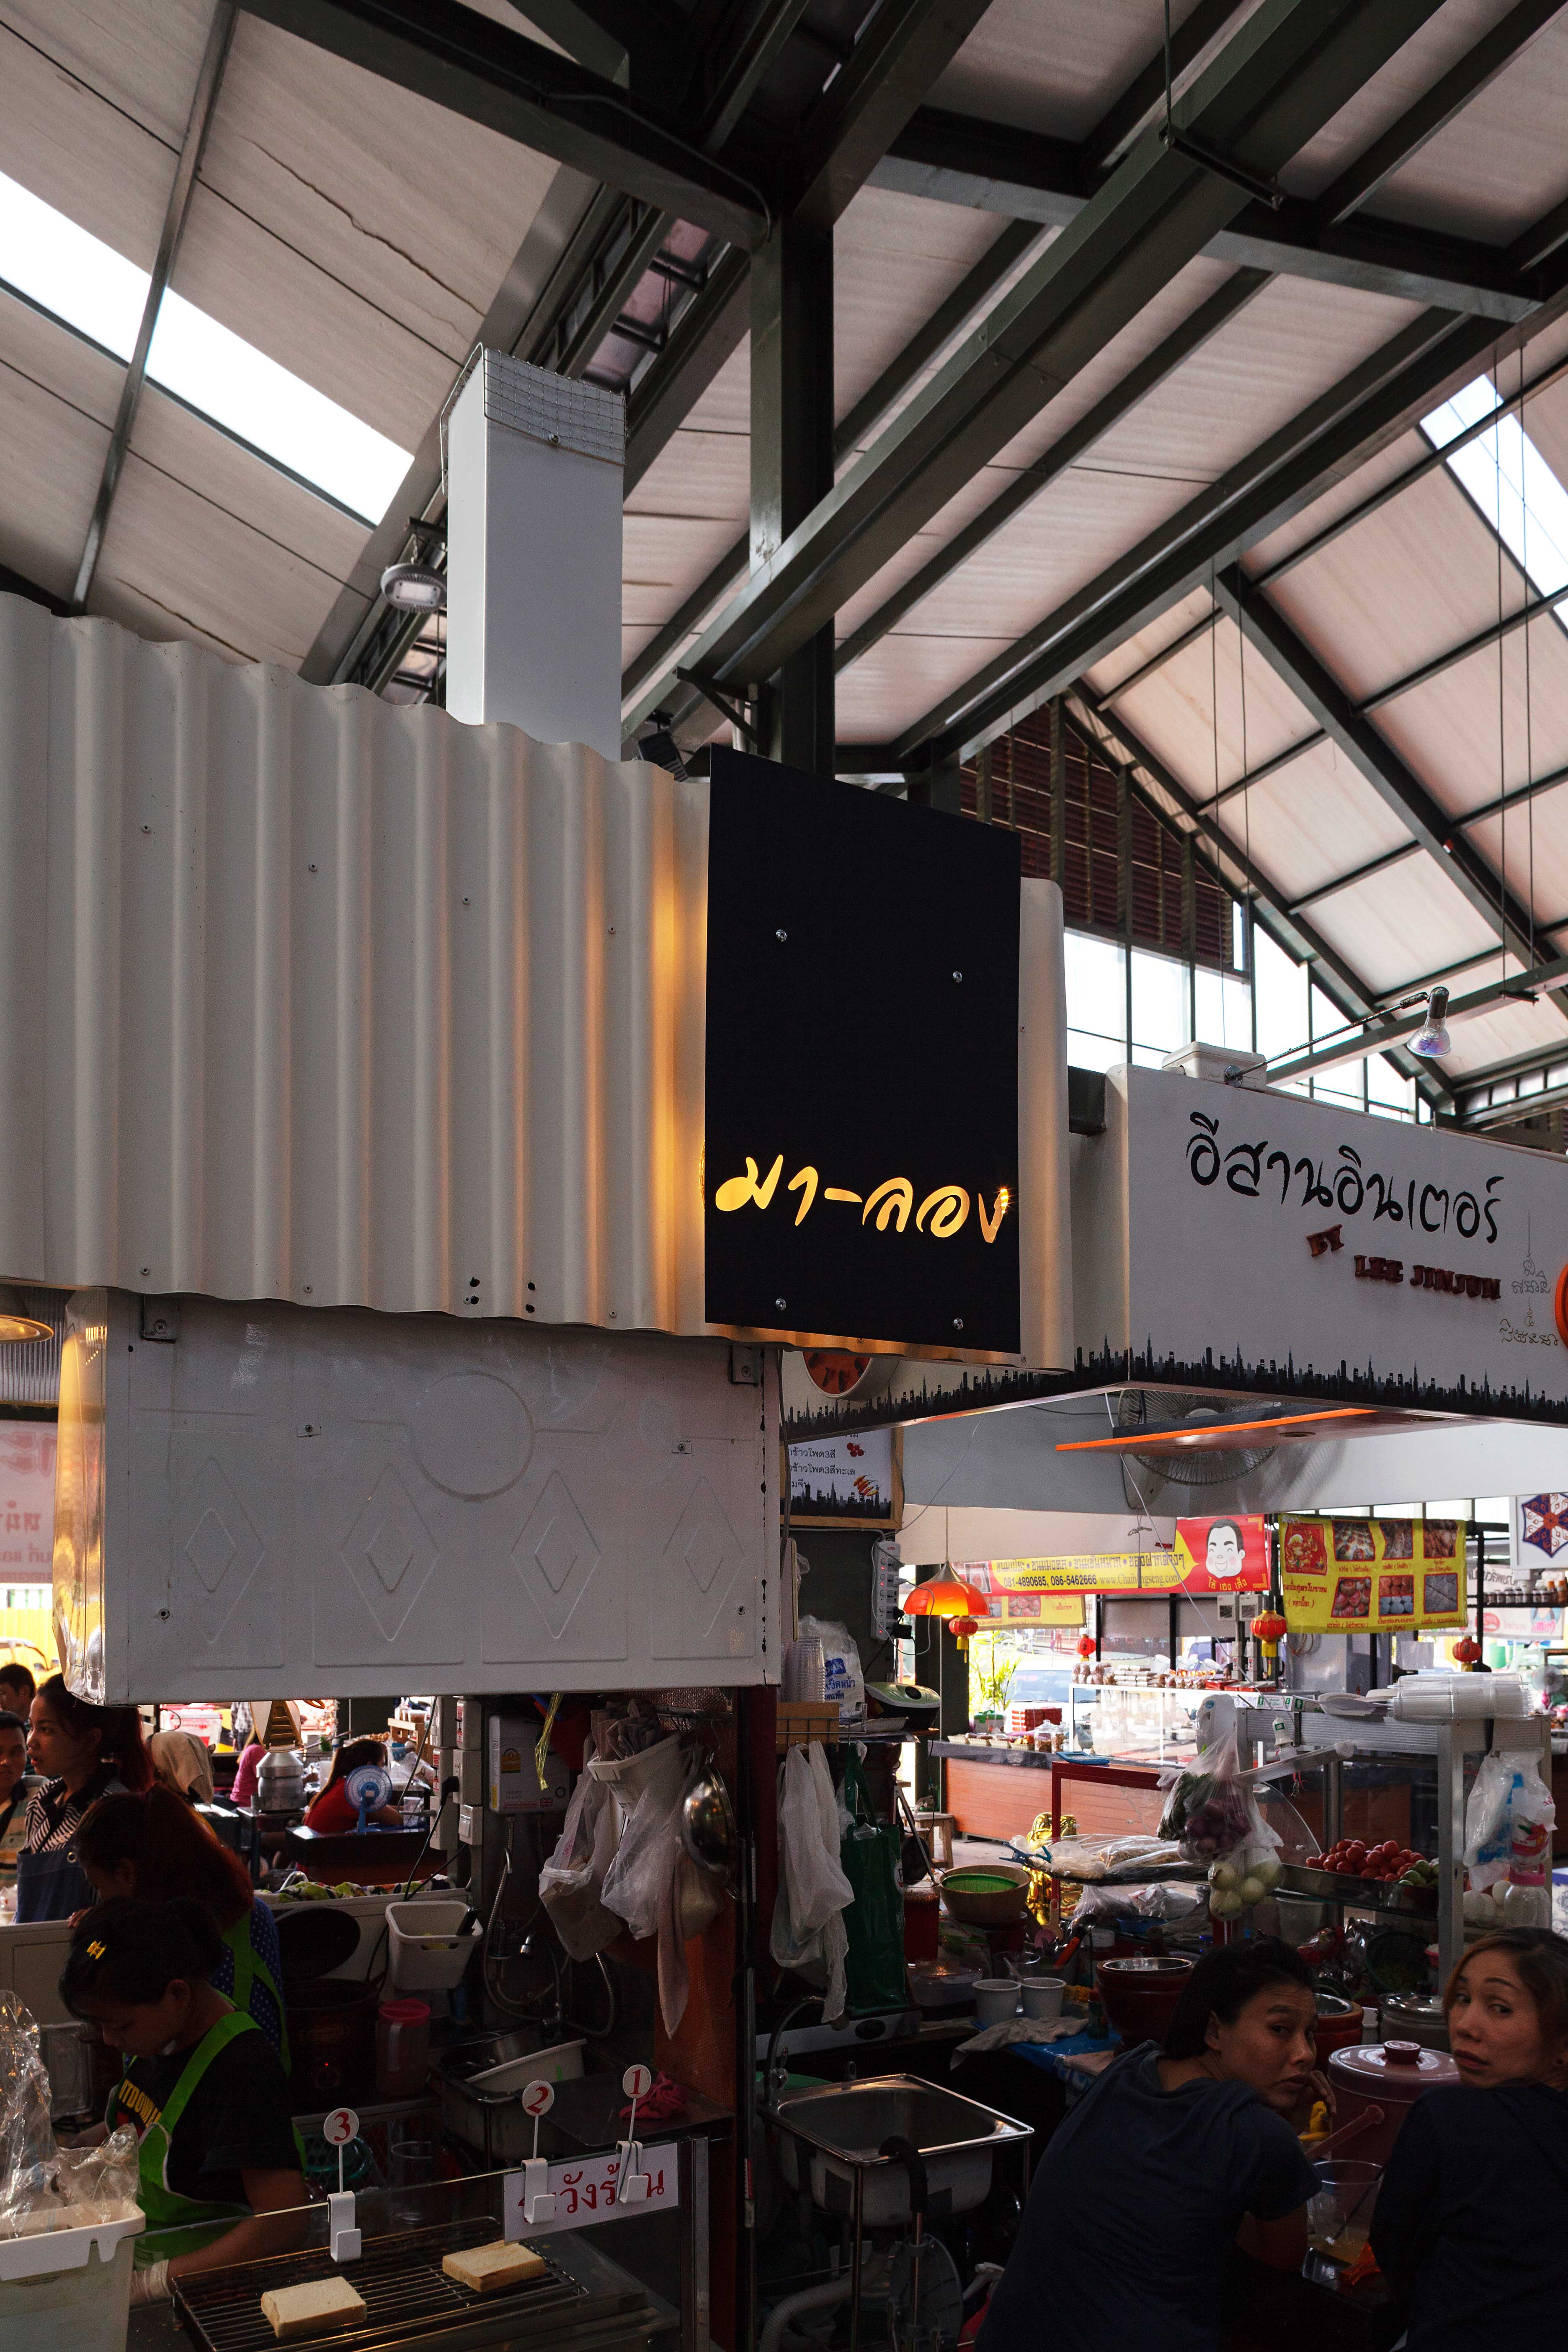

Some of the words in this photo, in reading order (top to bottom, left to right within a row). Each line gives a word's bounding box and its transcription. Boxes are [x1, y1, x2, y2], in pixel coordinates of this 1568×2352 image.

[1354, 1255, 1403, 1282] LEE
[1051, 1575, 1097, 1586] 086-5462666
[1099, 1573, 1180, 1586] www.Chaihngseng.com
[630, 2069, 641, 2095] 1
[527, 2086, 549, 2114] 2
[334, 2111, 351, 2141] 3
[518, 2162, 664, 2223] วังร้น
